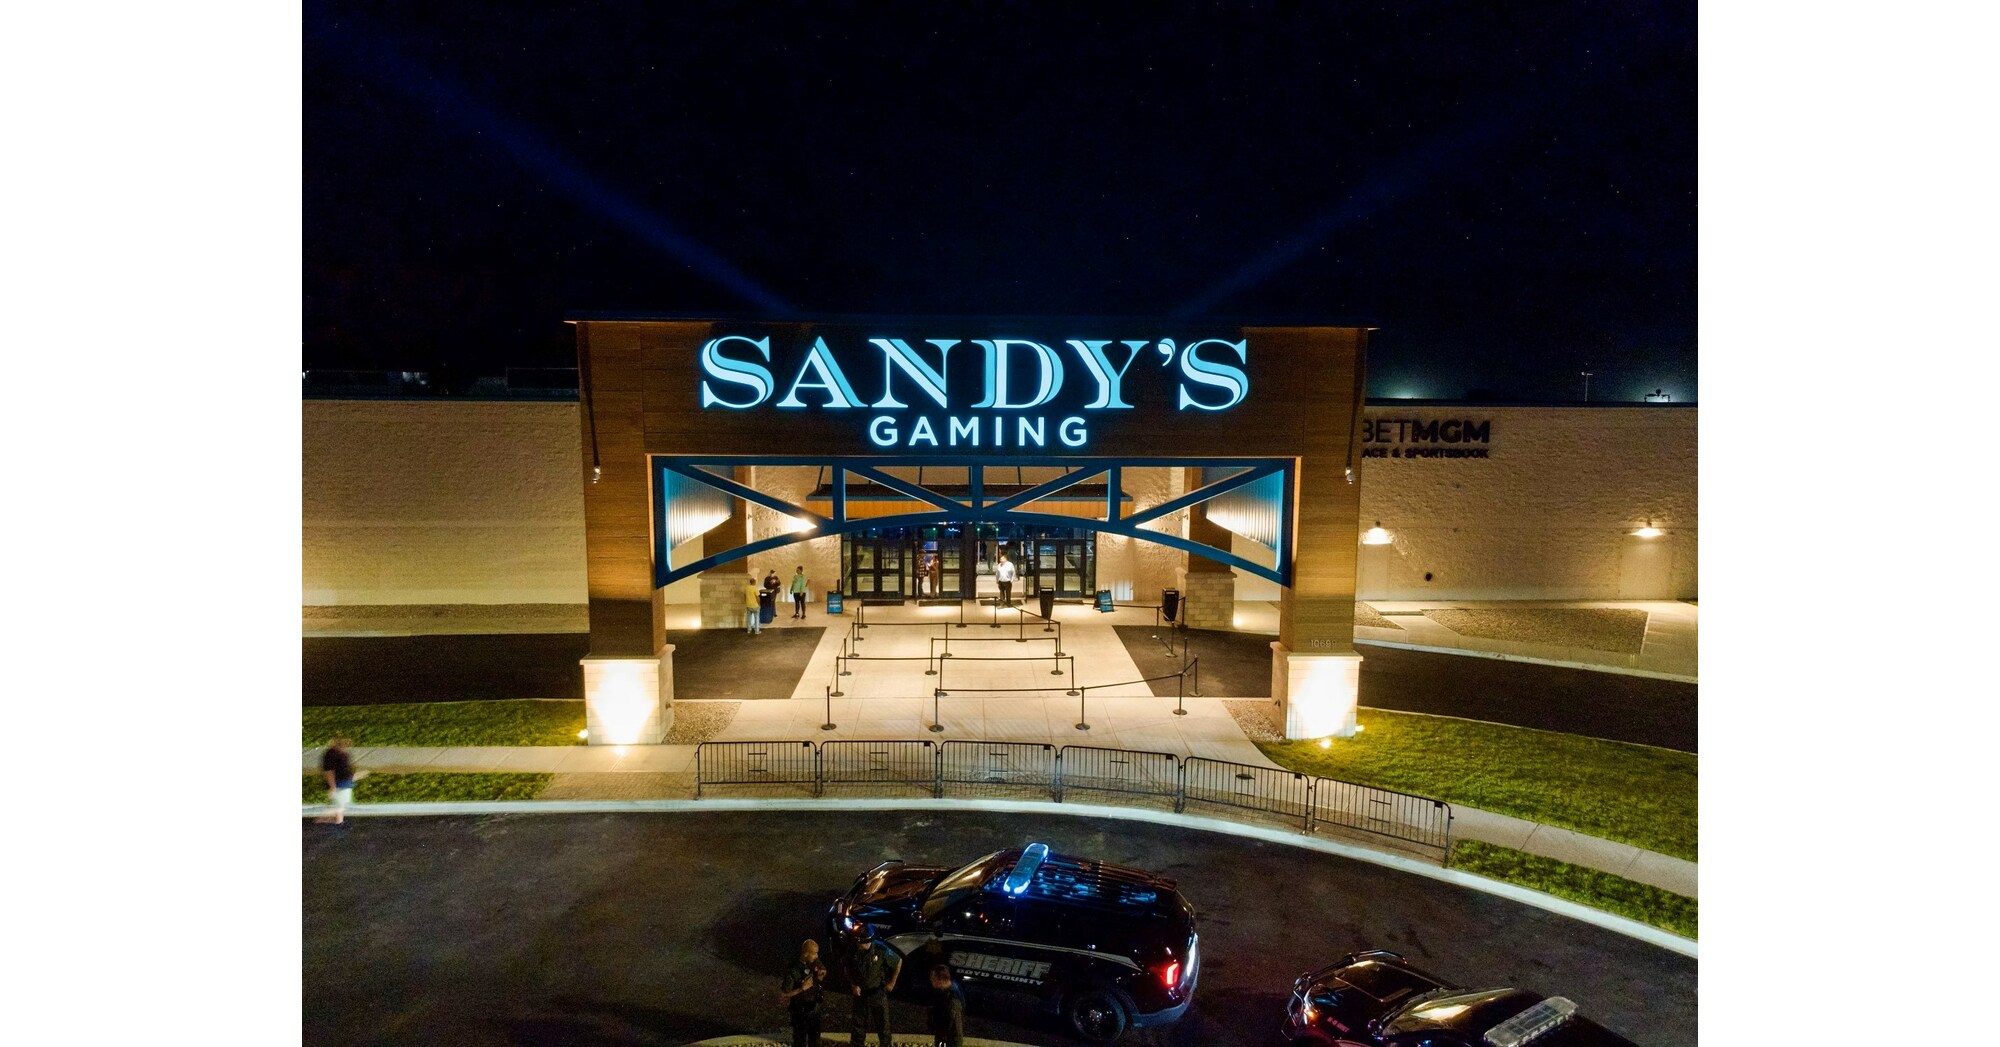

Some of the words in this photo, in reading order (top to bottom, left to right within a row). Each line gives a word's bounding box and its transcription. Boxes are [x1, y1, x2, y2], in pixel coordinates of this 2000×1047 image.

[701, 335, 1249, 410] SANDY'S
[870, 415, 1087, 447] GAMING
[1362, 448, 1388, 458] ACE
[1392, 448, 1401, 458] &
[1405, 448, 1489, 458] SPORTSBOOK
[950, 951, 1052, 979] SHERIFF
[956, 968, 990, 978] BOYD
[993, 973, 1044, 986] COUNTY
